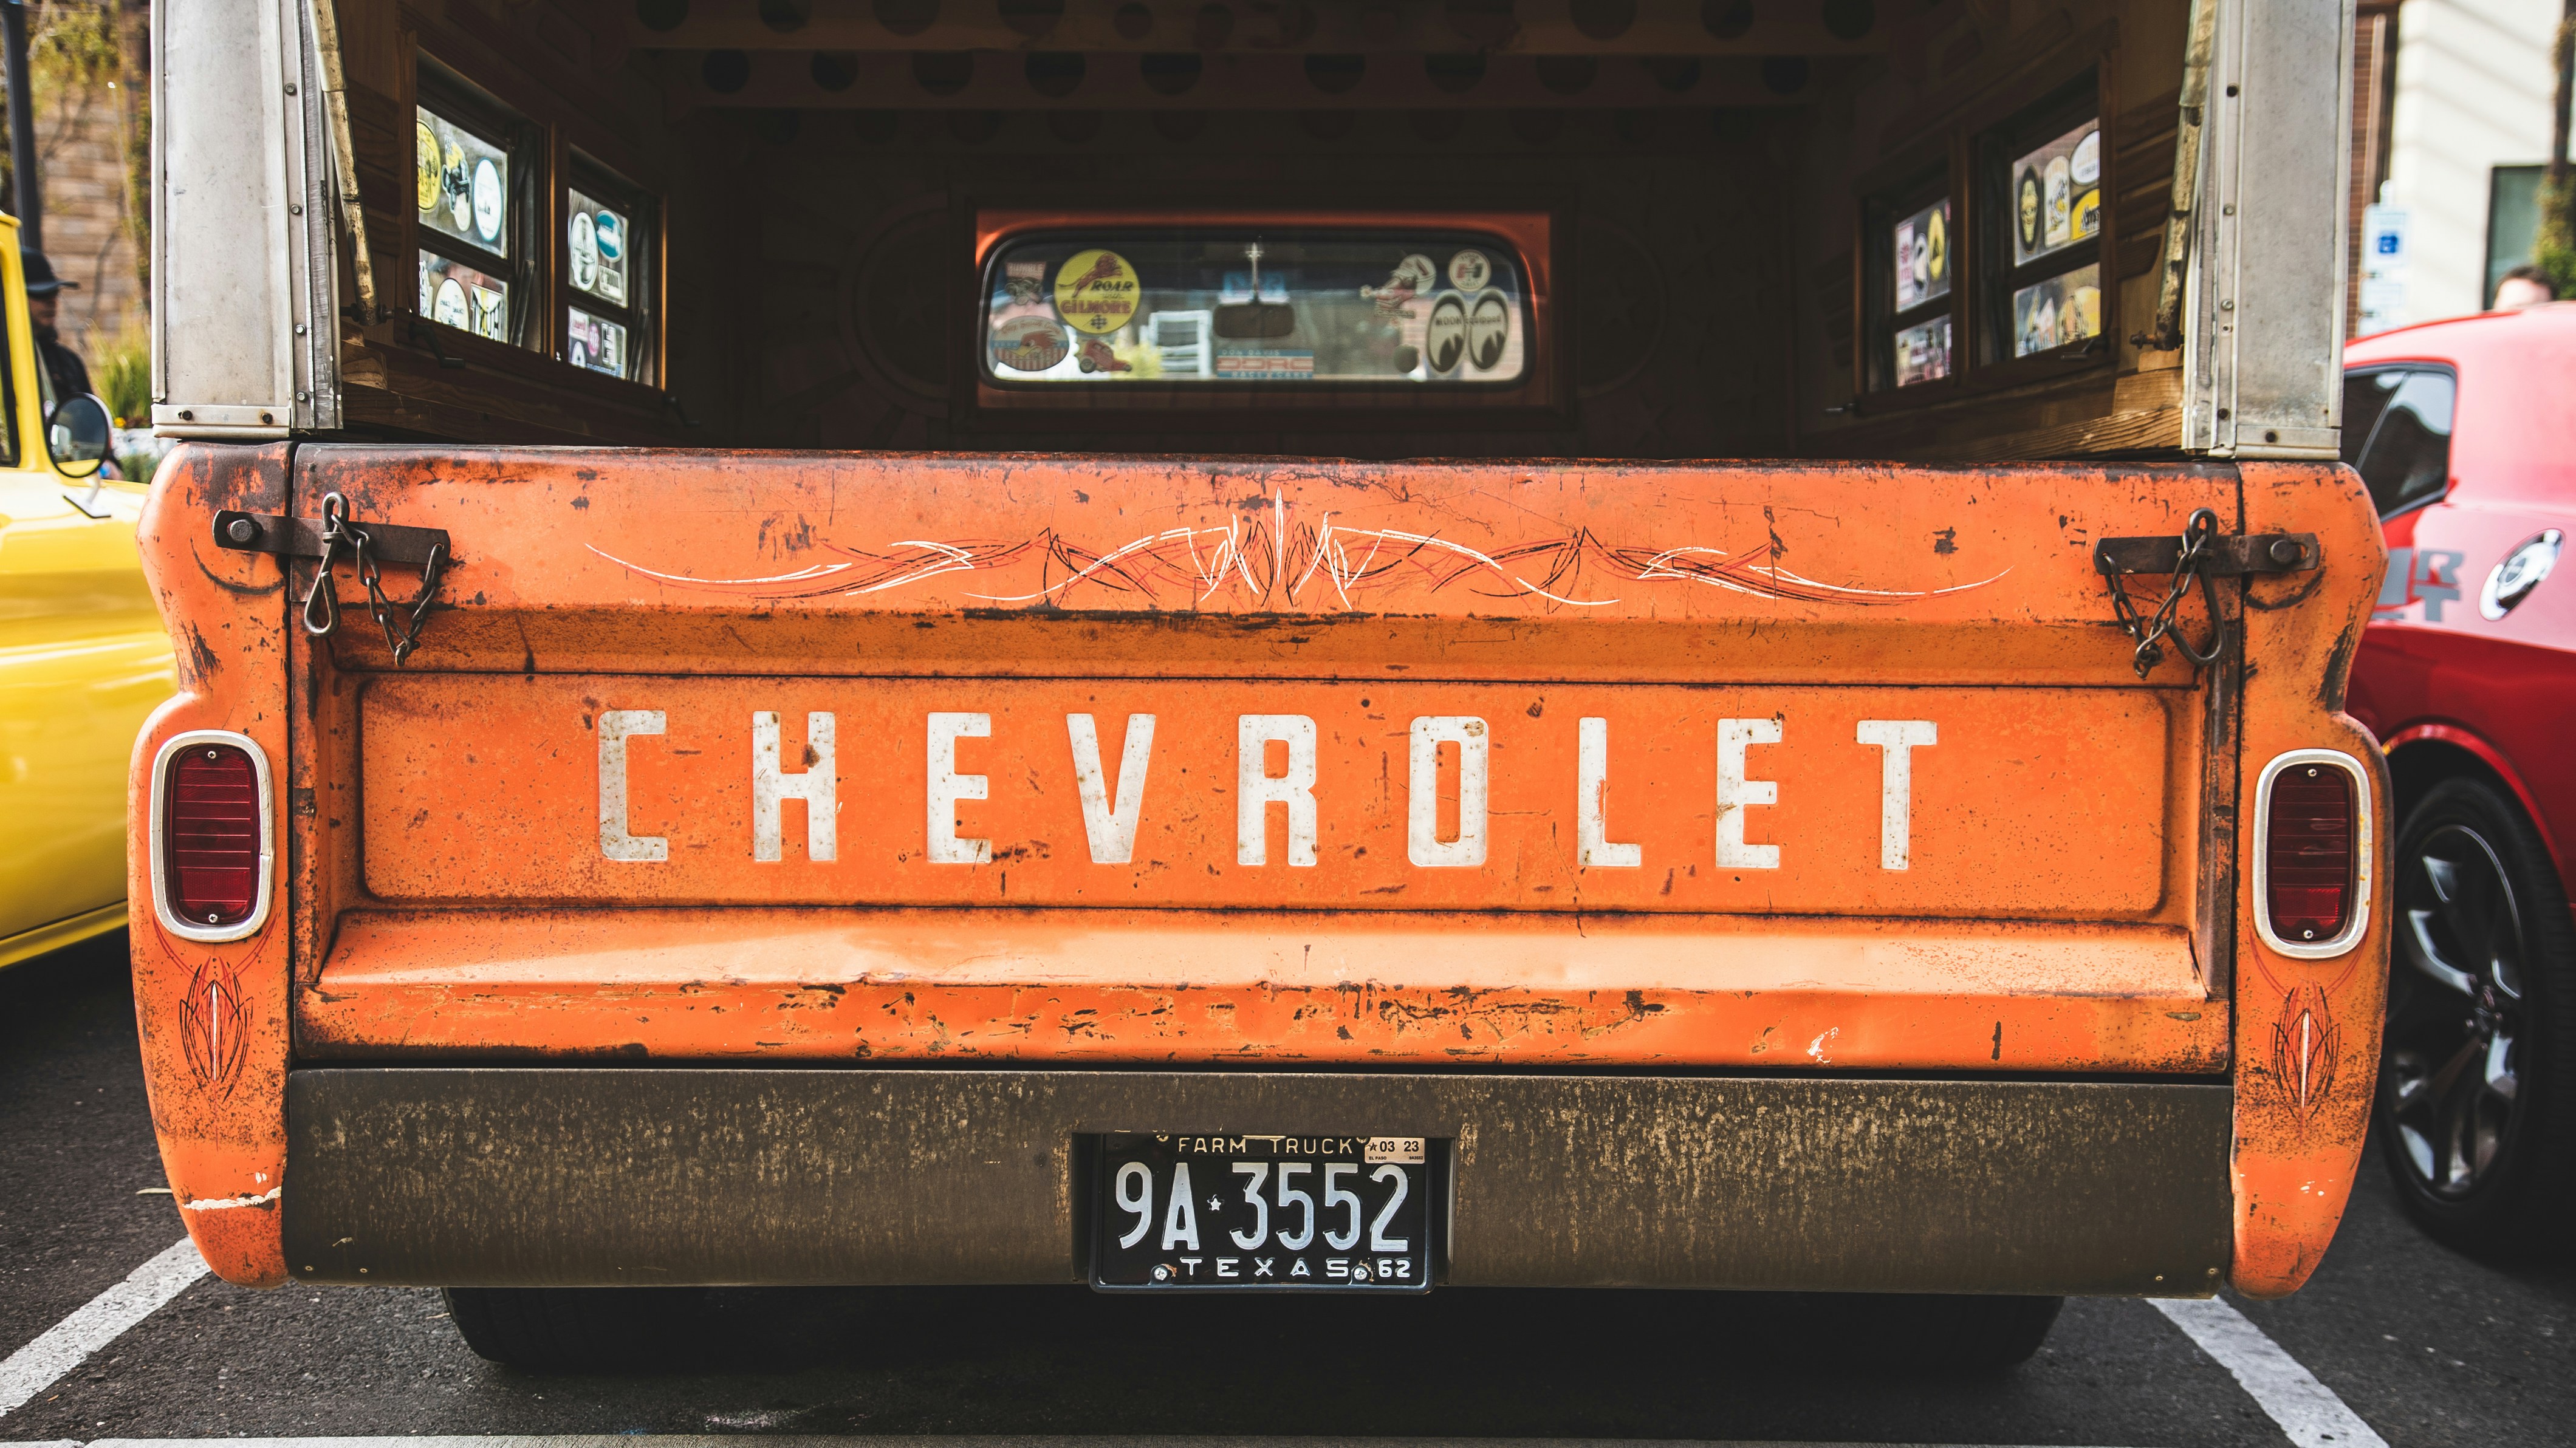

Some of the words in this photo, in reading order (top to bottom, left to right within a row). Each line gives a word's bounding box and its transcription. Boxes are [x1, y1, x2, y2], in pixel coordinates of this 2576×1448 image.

[1091, 280, 1134, 292] ROAR
[1060, 300, 1131, 313] GILMORE
[1435, 316, 1461, 326] MOON
[598, 709, 1938, 870] CHEVROLET
[1177, 1138, 1247, 1153] FARM
[1272, 1138, 1354, 1154] TRUCK
[1379, 1141, 1396, 1152] 03
[1403, 1141, 1419, 1152] 23
[1115, 1162, 1200, 1251] 9A
[1229, 1162, 1410, 1252] 3552
[1180, 1257, 1350, 1278] TEXAS
[1377, 1257, 1412, 1278] 62
